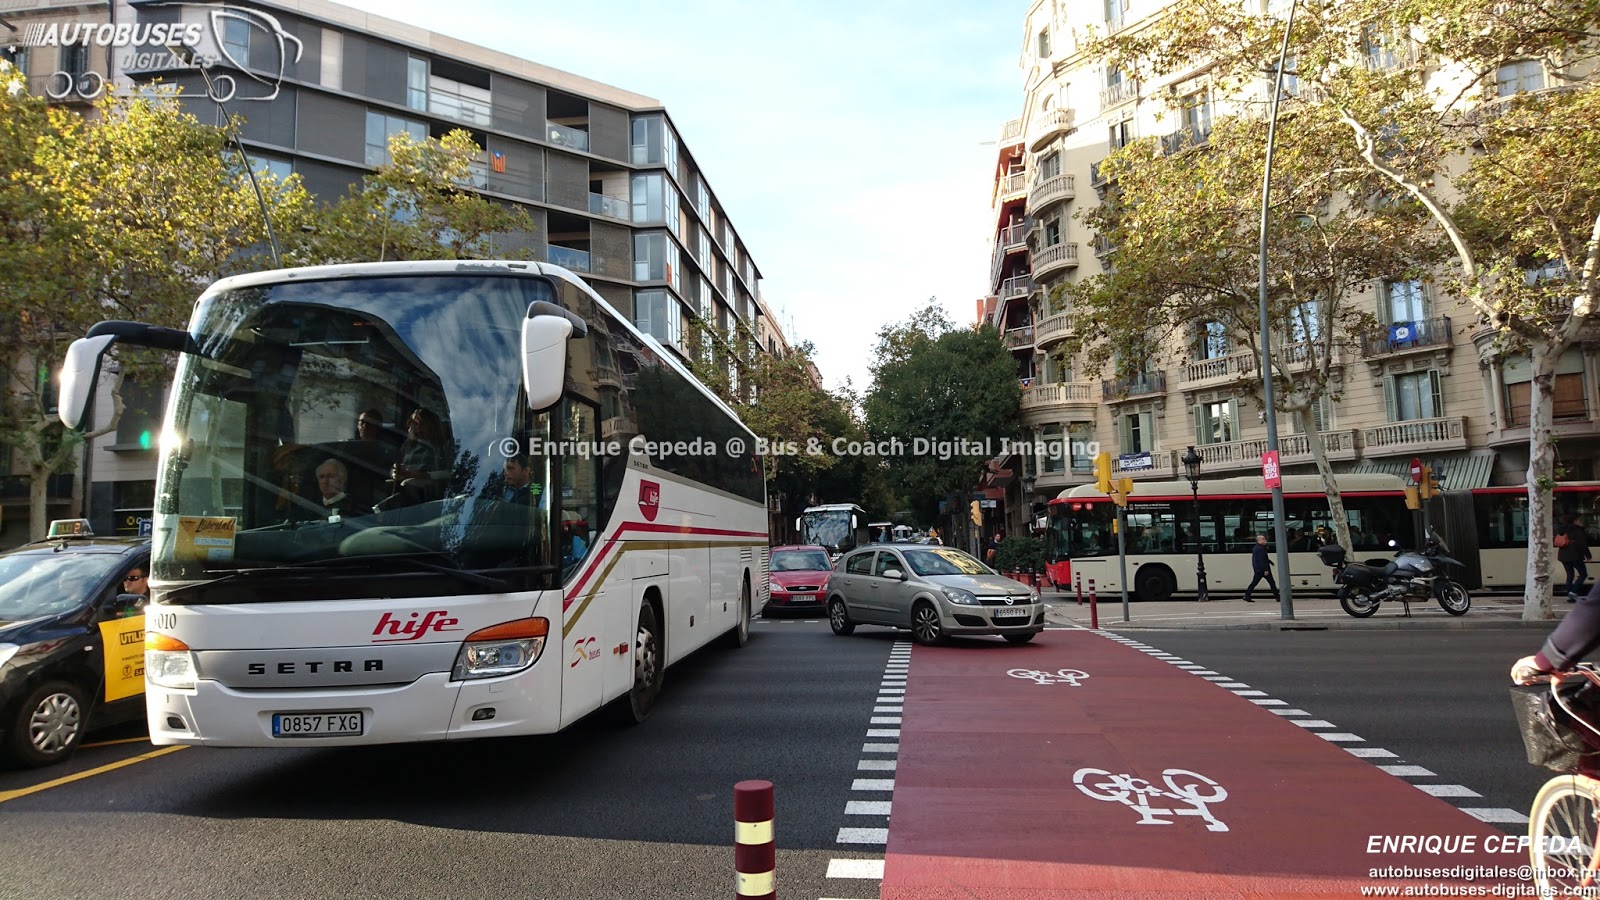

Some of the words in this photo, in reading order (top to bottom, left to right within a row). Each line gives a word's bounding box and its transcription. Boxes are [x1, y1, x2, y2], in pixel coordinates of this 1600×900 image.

[144, 524, 151, 532] P
[371, 610, 464, 642] hife
[248, 659, 384, 675] SETRA
[282, 715, 321, 732] 0857
[327, 714, 358, 731] FXG
